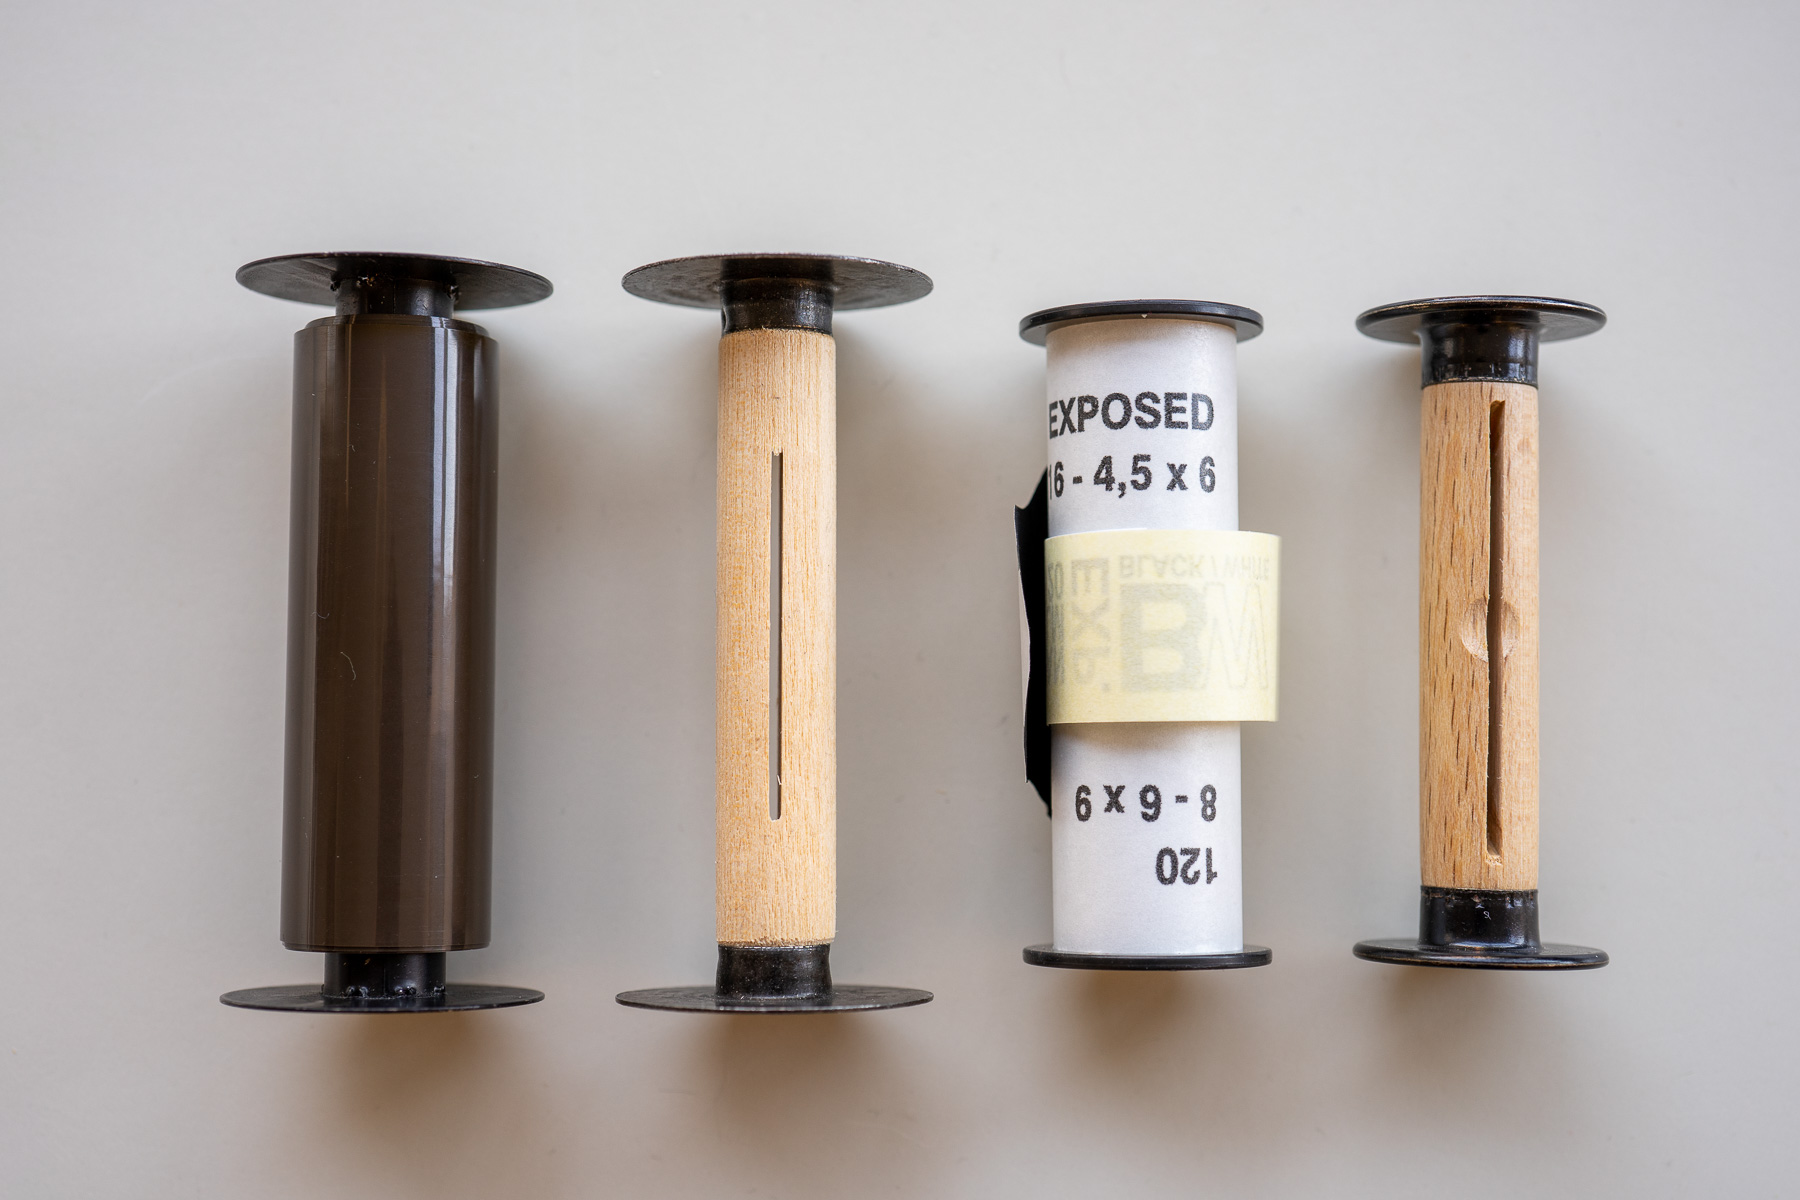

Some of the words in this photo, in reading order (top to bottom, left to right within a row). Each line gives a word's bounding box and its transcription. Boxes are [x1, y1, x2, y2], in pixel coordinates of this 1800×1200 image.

[1048, 391, 1214, 439] EXPOSED
[1072, 475, 1083, 485] -
[1093, 454, 1152, 498] 4,5
[1166, 462, 1188, 491] x
[1199, 455, 1216, 493] 6
[1075, 784, 1092, 822] 9
[1103, 784, 1126, 813] x
[1139, 783, 1162, 822] 6
[1175, 794, 1188, 804] -
[1200, 783, 1217, 822] 8
[1155, 846, 1218, 886] 120
